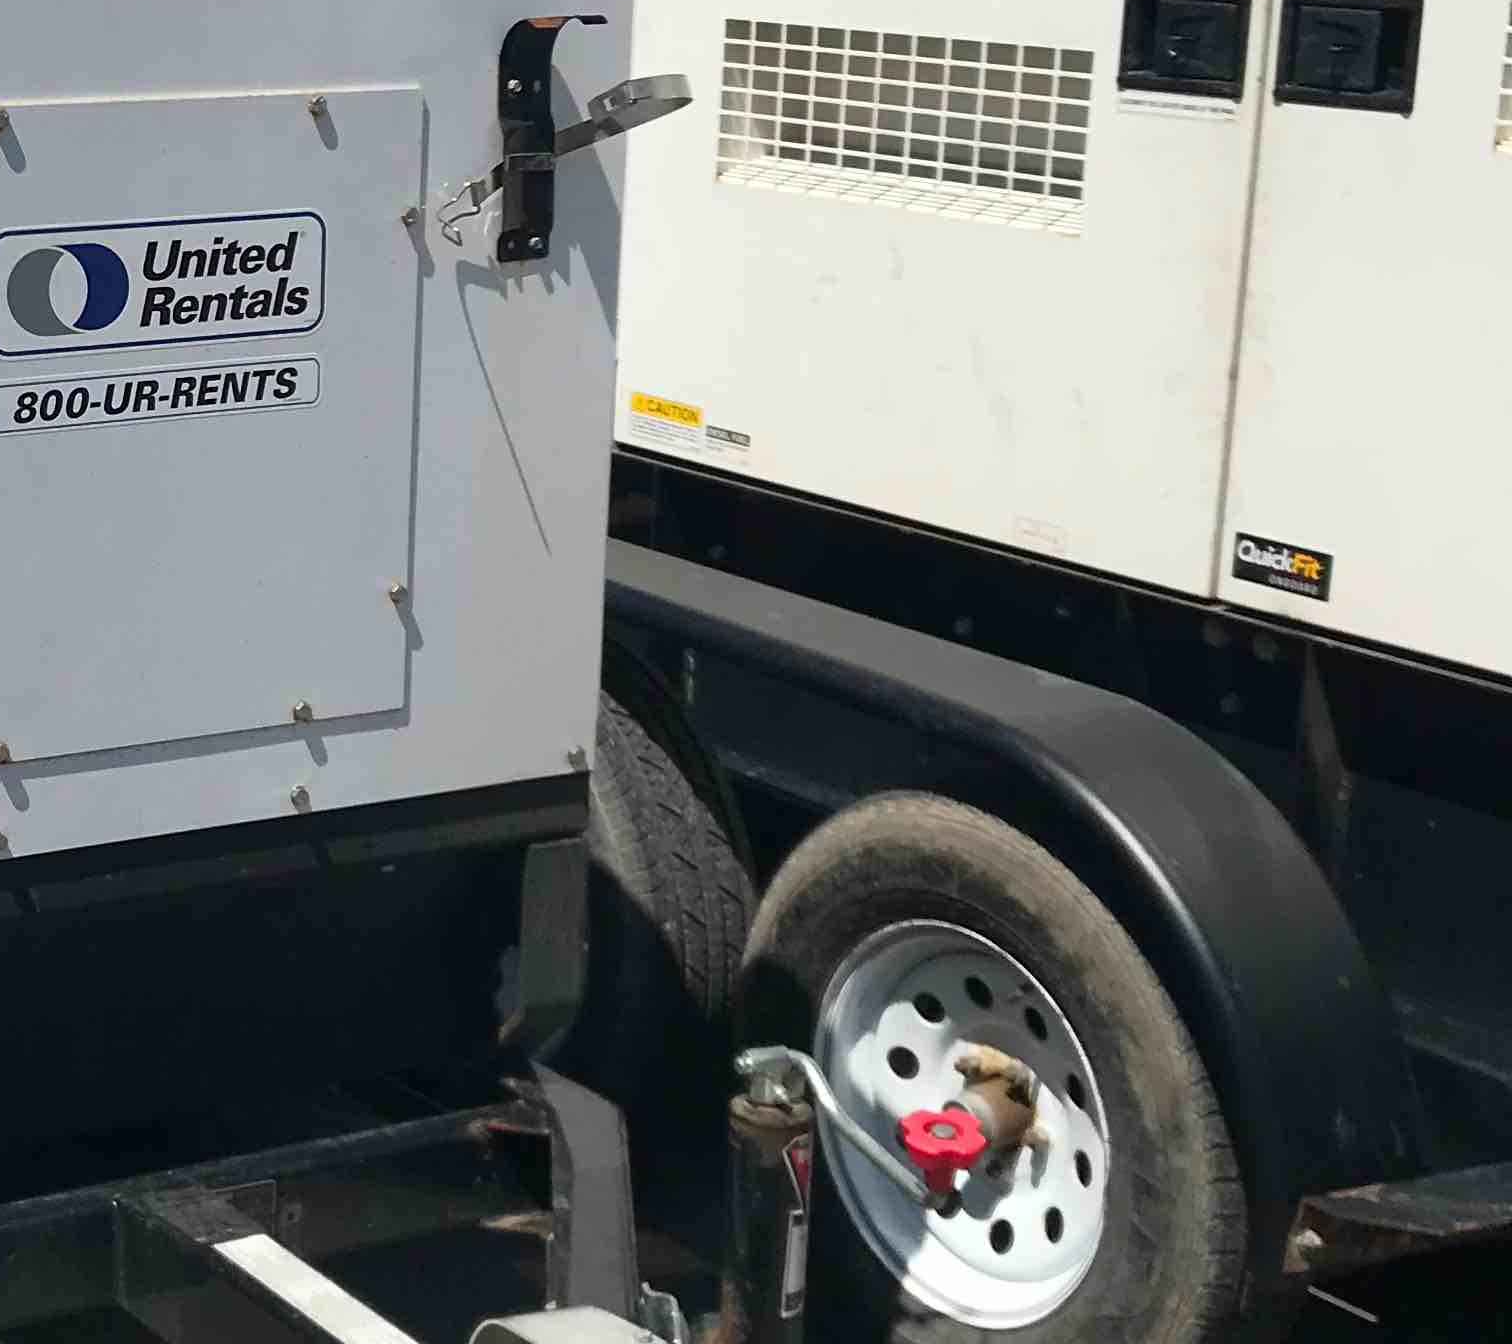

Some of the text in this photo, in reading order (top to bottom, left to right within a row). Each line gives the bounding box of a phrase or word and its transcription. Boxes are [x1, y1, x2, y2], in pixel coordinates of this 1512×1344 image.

[142, 231, 299, 281] United
[140, 277, 310, 327] Rentals
[13, 367, 298, 424] 800-UR-RENTS
